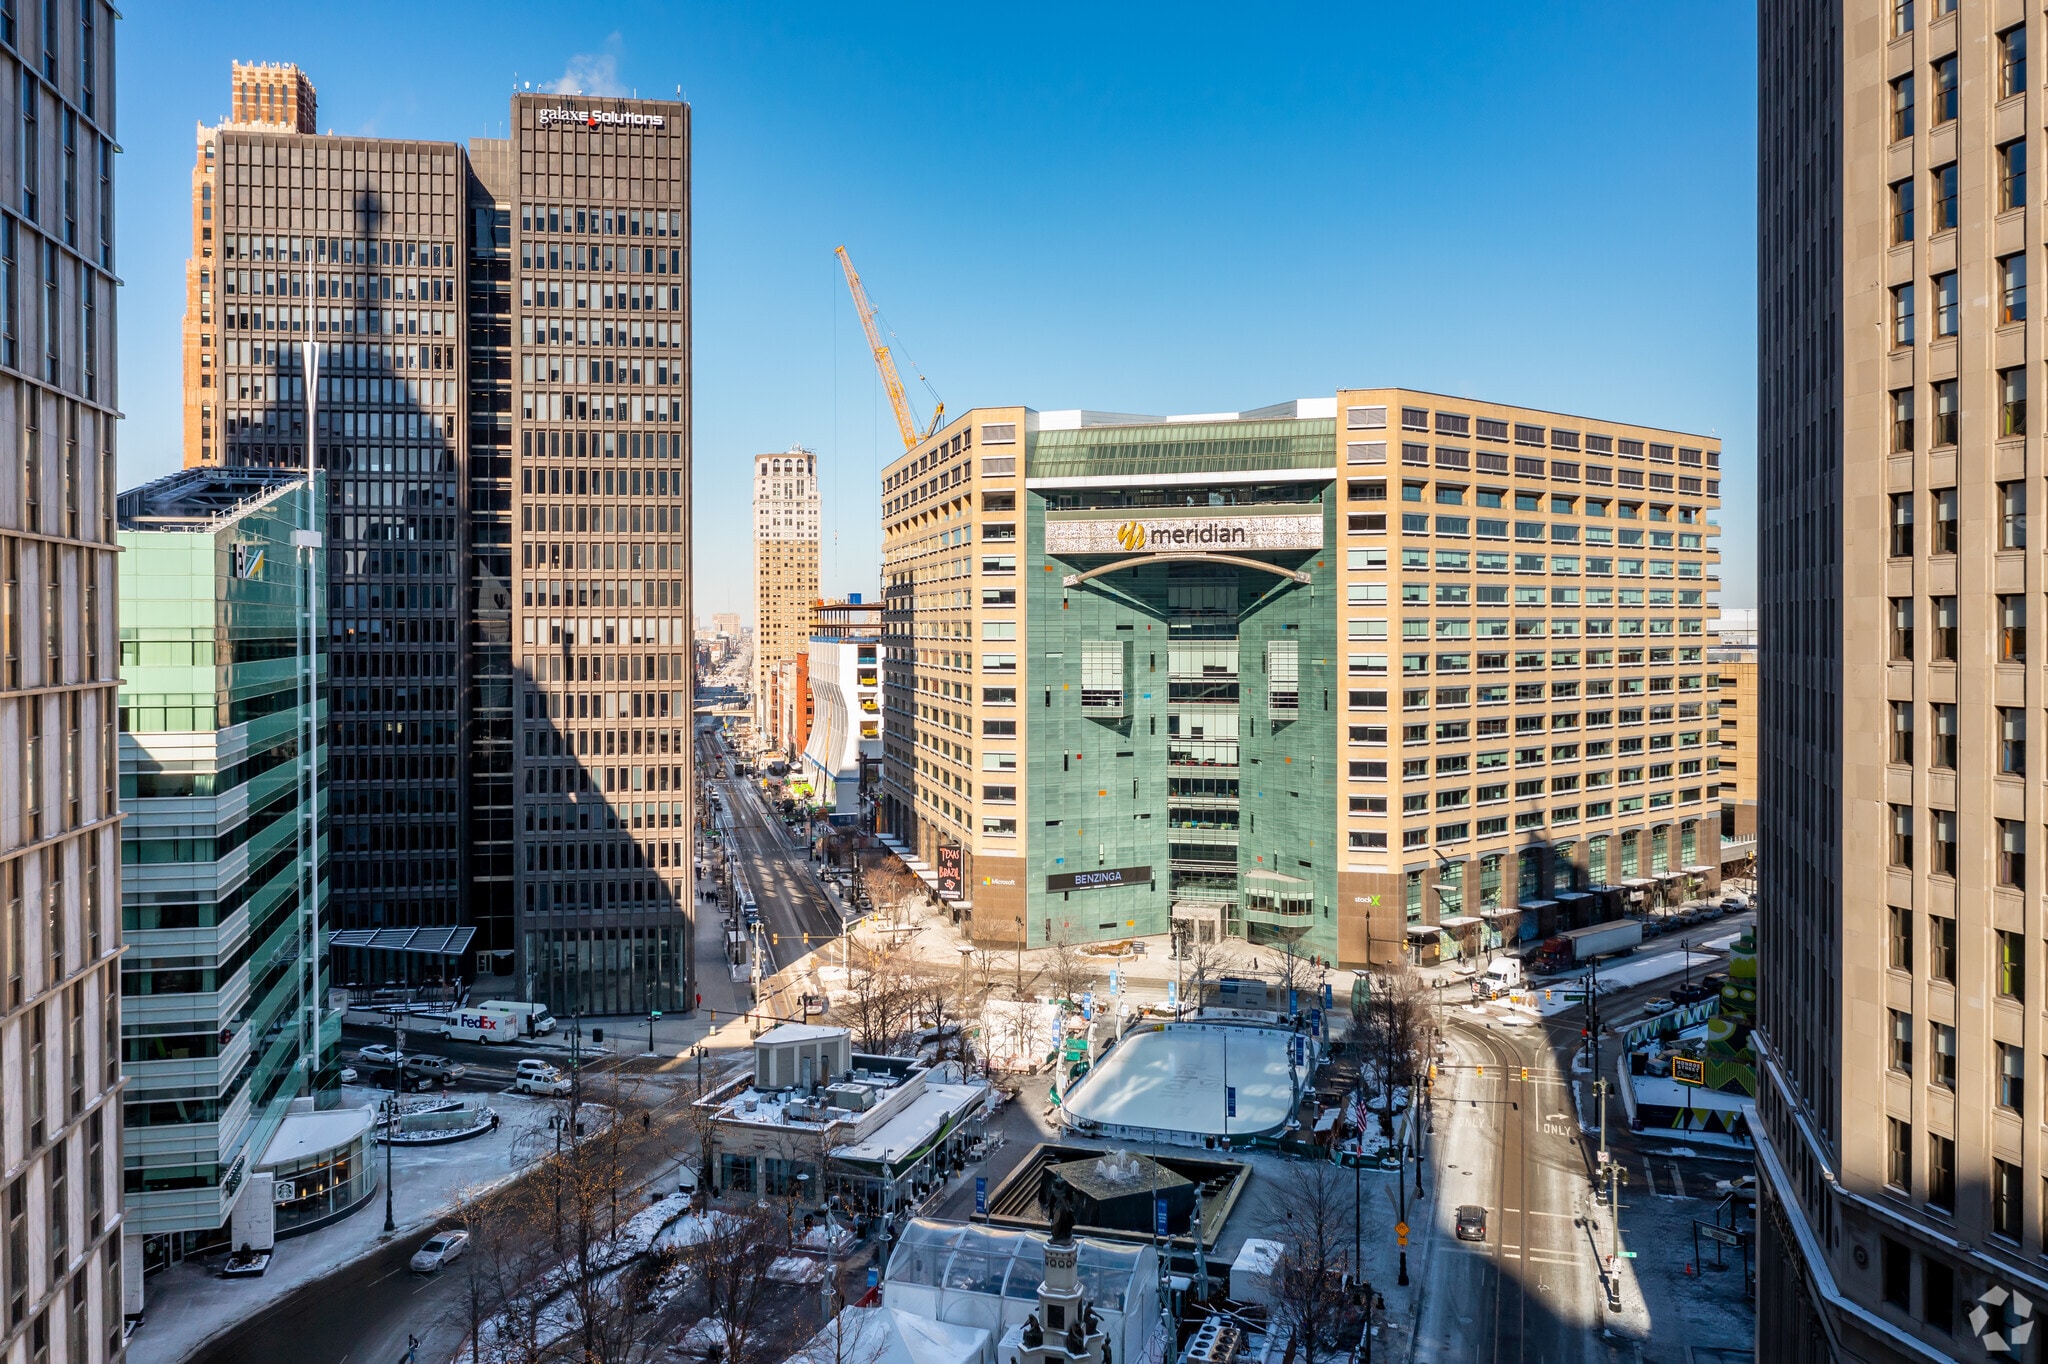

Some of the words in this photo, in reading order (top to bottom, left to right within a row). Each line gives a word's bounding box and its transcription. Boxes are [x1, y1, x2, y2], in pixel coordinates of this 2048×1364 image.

[591, 110, 663, 126] Solutions
[1151, 523, 1245, 544] meridian
[940, 848, 960, 861] TEXAS
[939, 866, 961, 880] BRAZIL
[1075, 871, 1122, 885] BENZINGA
[991, 878, 1016, 886] Microsoft
[461, 1013, 497, 1030] FedEx
[1676, 1060, 1700, 1069] MONROE
[1677, 1064, 1699, 1073] STREET
[1543, 1123, 1571, 1136] ONLY
